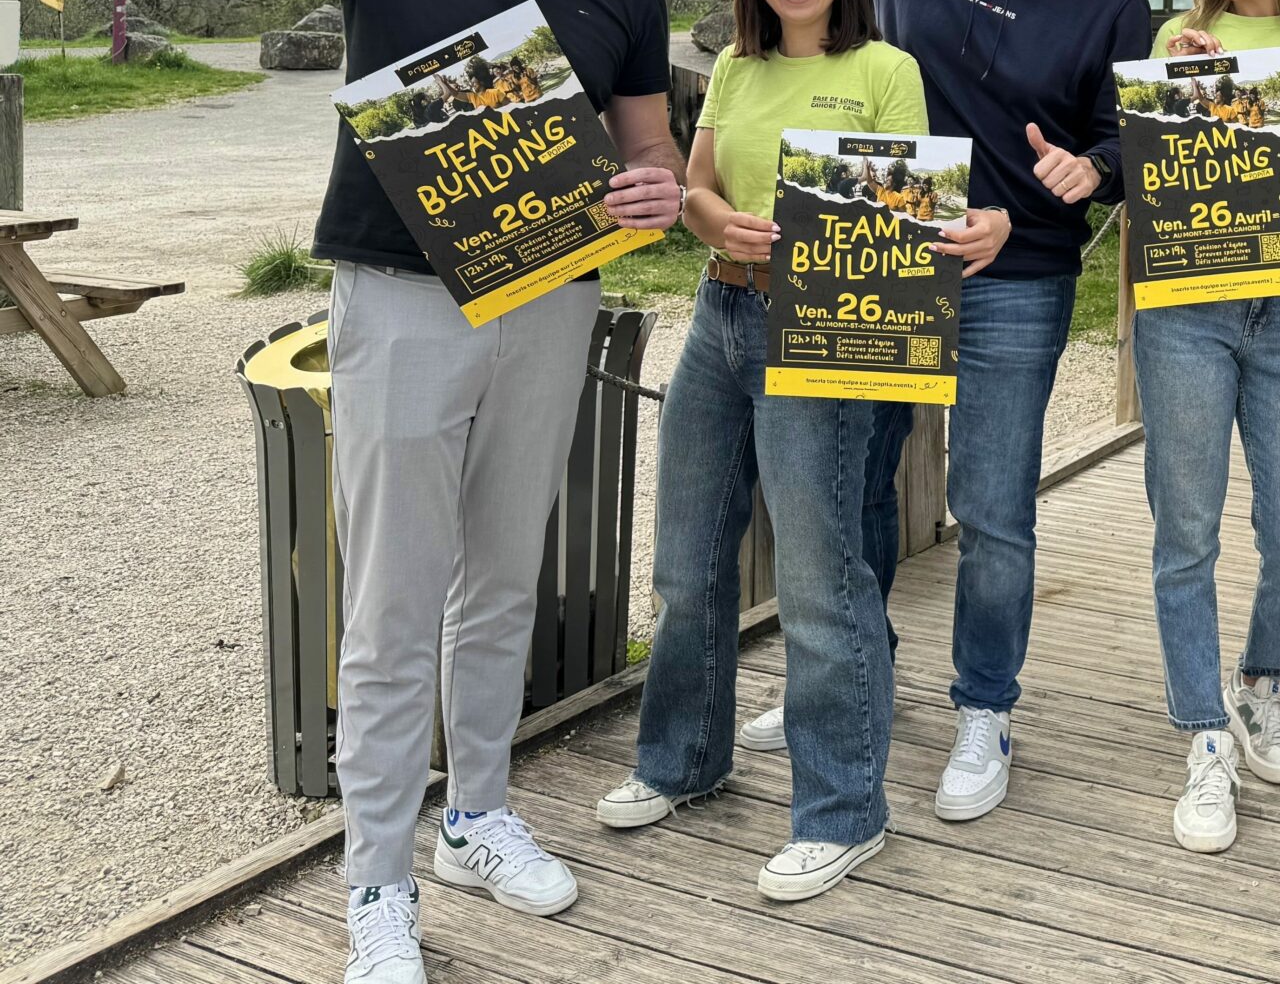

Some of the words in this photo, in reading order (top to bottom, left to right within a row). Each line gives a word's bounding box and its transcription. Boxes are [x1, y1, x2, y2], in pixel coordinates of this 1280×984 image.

[840, 98, 864, 107] LOISIRS
[843, 106, 862, 114] CATUS
[424, 112, 521, 172] TEAM
[1161, 126, 1237, 165] TEAM
[417, 116, 565, 215] BUILDING
[1143, 146, 1271, 191] BUILDING
[453, 230, 497, 252] Ven.
[493, 191, 547, 233] 26
[551, 181, 593, 210] Avril
[497, 218, 547, 245] MONT-ST-CYR
[553, 201, 584, 217] CAHORS
[818, 213, 901, 249] TEAM
[1152, 220, 1187, 233] Ven.
[1190, 200, 1232, 229] 26
[1235, 210, 1271, 225] Avril
[791, 240, 933, 280] BUILDING
[795, 304, 832, 319] Ven.
[837, 292, 882, 322] 26
[884, 309, 925, 325] Avril
[882, 324, 911, 332] CAHORS
